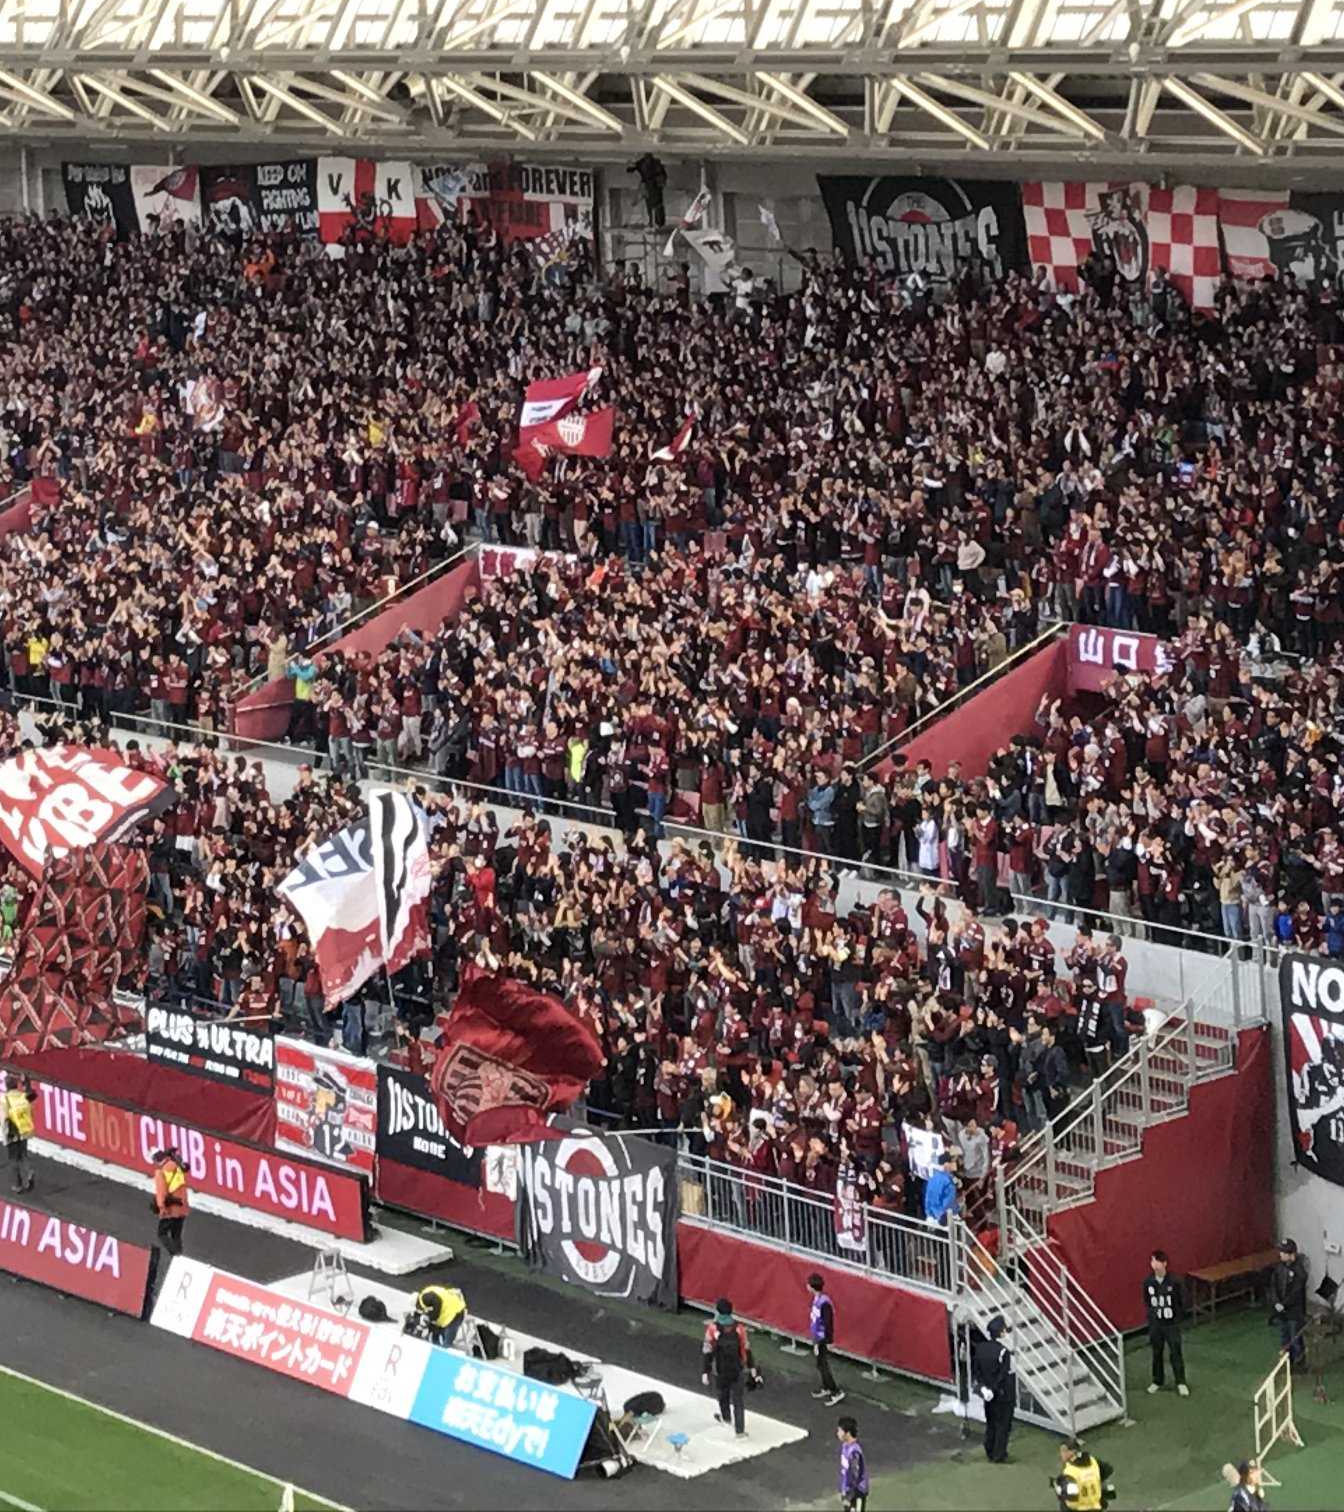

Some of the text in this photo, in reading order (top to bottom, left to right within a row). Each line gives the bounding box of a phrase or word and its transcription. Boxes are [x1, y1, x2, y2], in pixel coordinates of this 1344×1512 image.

[521, 167, 591, 198] OREVER
[148, 1007, 194, 1046] PLUS
[209, 1024, 273, 1070] ULTRA
[39, 1082, 88, 1141] THE
[89, 1103, 136, 1158] No.1
[139, 1115, 207, 1181] CLUB
[215, 1140, 245, 1193] in
[255, 1159, 338, 1223] ASIA
[1, 1199, 31, 1249] in
[37, 1217, 122, 1279] ASIA
[203, 1307, 353, 1385] 楽天ポイントカード
